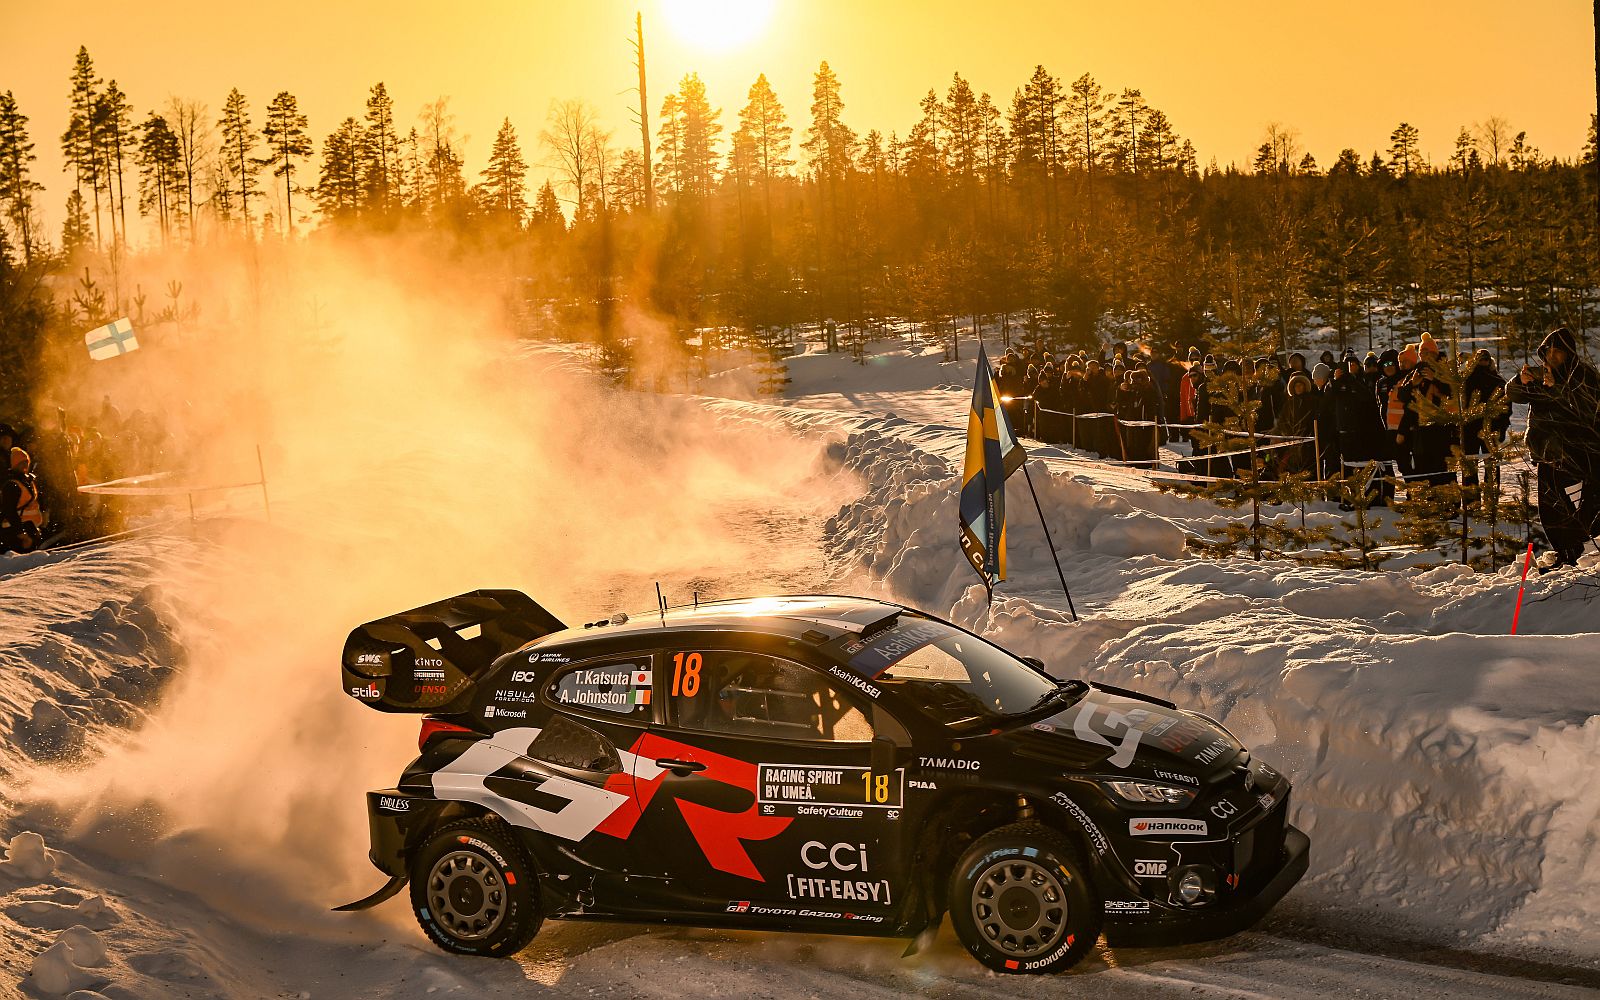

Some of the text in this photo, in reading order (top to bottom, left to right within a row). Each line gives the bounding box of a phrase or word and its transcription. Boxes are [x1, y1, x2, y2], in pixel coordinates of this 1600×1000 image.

[575, 671, 629, 685] T.Katsuta
[671, 652, 703, 698] 18
[828, 665, 882, 699] AsahiKASEI
[351, 684, 380, 698] Stilo
[414, 685, 447, 693] DENSO
[495, 689, 535, 699] NISULA
[559, 689, 627, 704] A.Johnston
[495, 708, 527, 719] Microsoft
[919, 756, 981, 770] TAMADIC
[765, 768, 843, 785] RACING SPIRIT
[765, 783, 816, 800] BY UMEÅ.
[861, 771, 889, 804] 18
[908, 780, 937, 790] PIAA
[380, 796, 410, 810] ENDLESS
[763, 805, 899, 818] SC SafetyCulture SC
[1048, 795, 1106, 856] AUTOMOTIVE
[1055, 791, 1108, 850] Panasonic
[1148, 822, 1204, 832] Hankook
[468, 837, 508, 868] Hankook
[1134, 862, 1168, 875] OMP
[750, 906, 796, 916] TOYOTA
[798, 909, 842, 919] GAZOO
[842, 912, 884, 923] Racing
[1025, 942, 1070, 970] Hankook
